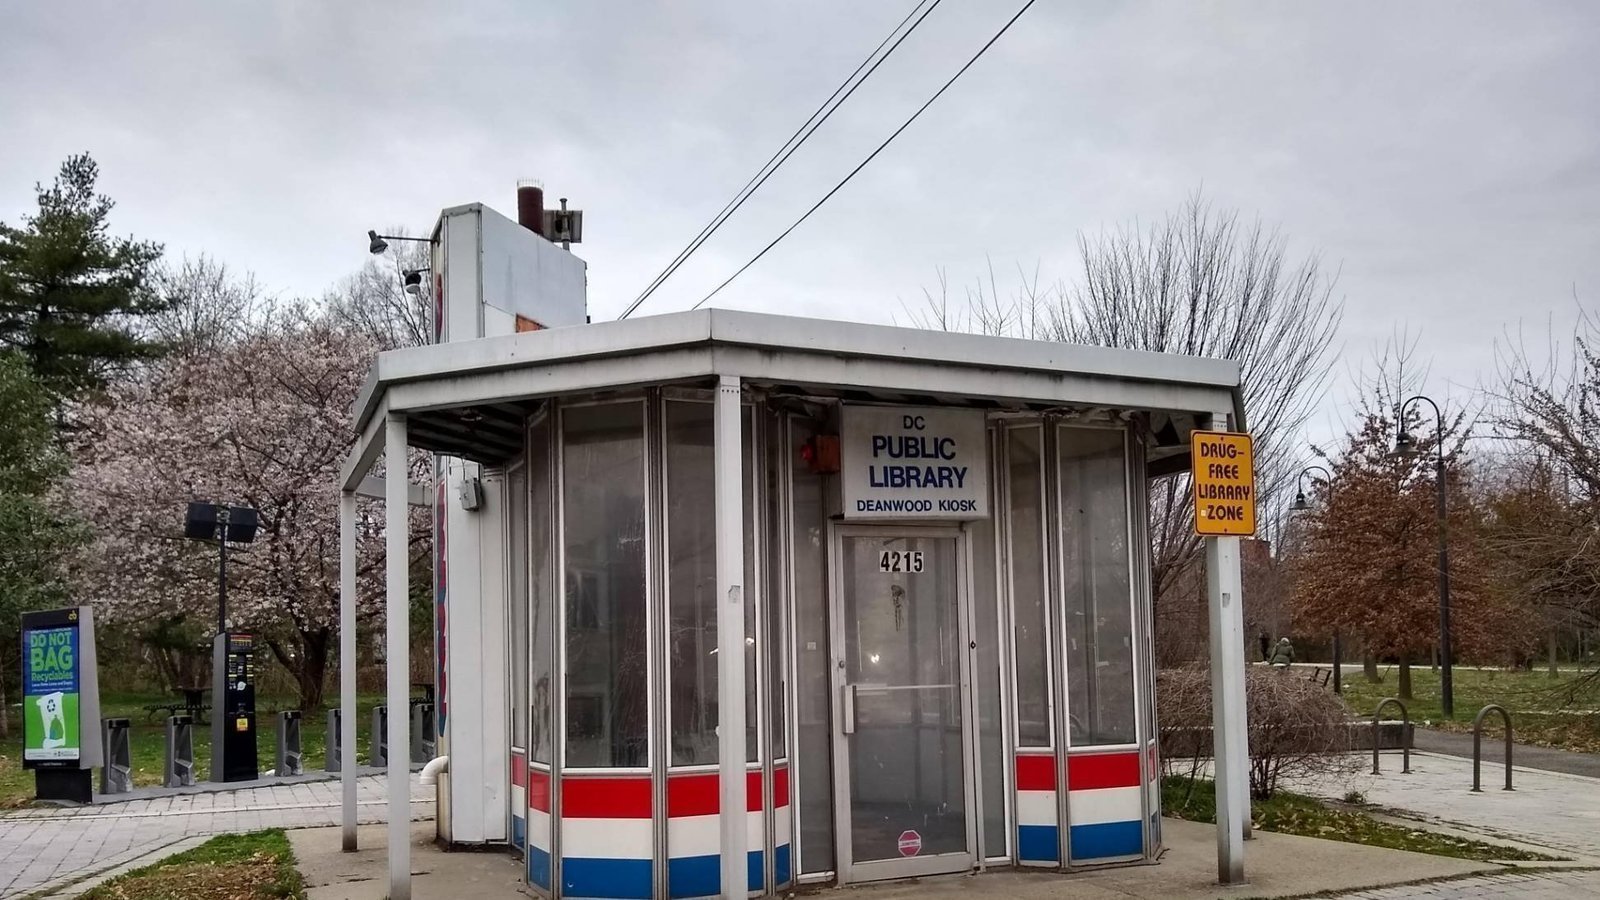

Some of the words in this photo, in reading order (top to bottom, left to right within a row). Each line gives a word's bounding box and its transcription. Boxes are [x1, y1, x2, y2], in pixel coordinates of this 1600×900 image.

[903, 415, 926, 430] DC
[872, 435, 956, 460] PUBLIC
[1201, 442, 1245, 459] DRUG-
[869, 465, 968, 489] LIBRARY
[1208, 463, 1239, 480] FREE
[1198, 484, 1250, 500] LIBRARY
[857, 500, 932, 512] DEANWOOD
[938, 499, 977, 512] KIOSK
[1207, 504, 1244, 521] ZONE
[880, 551, 923, 573] 4215
[31, 633, 47, 648] DO
[49, 631, 72, 646] NOT
[31, 645, 73, 672] BAG
